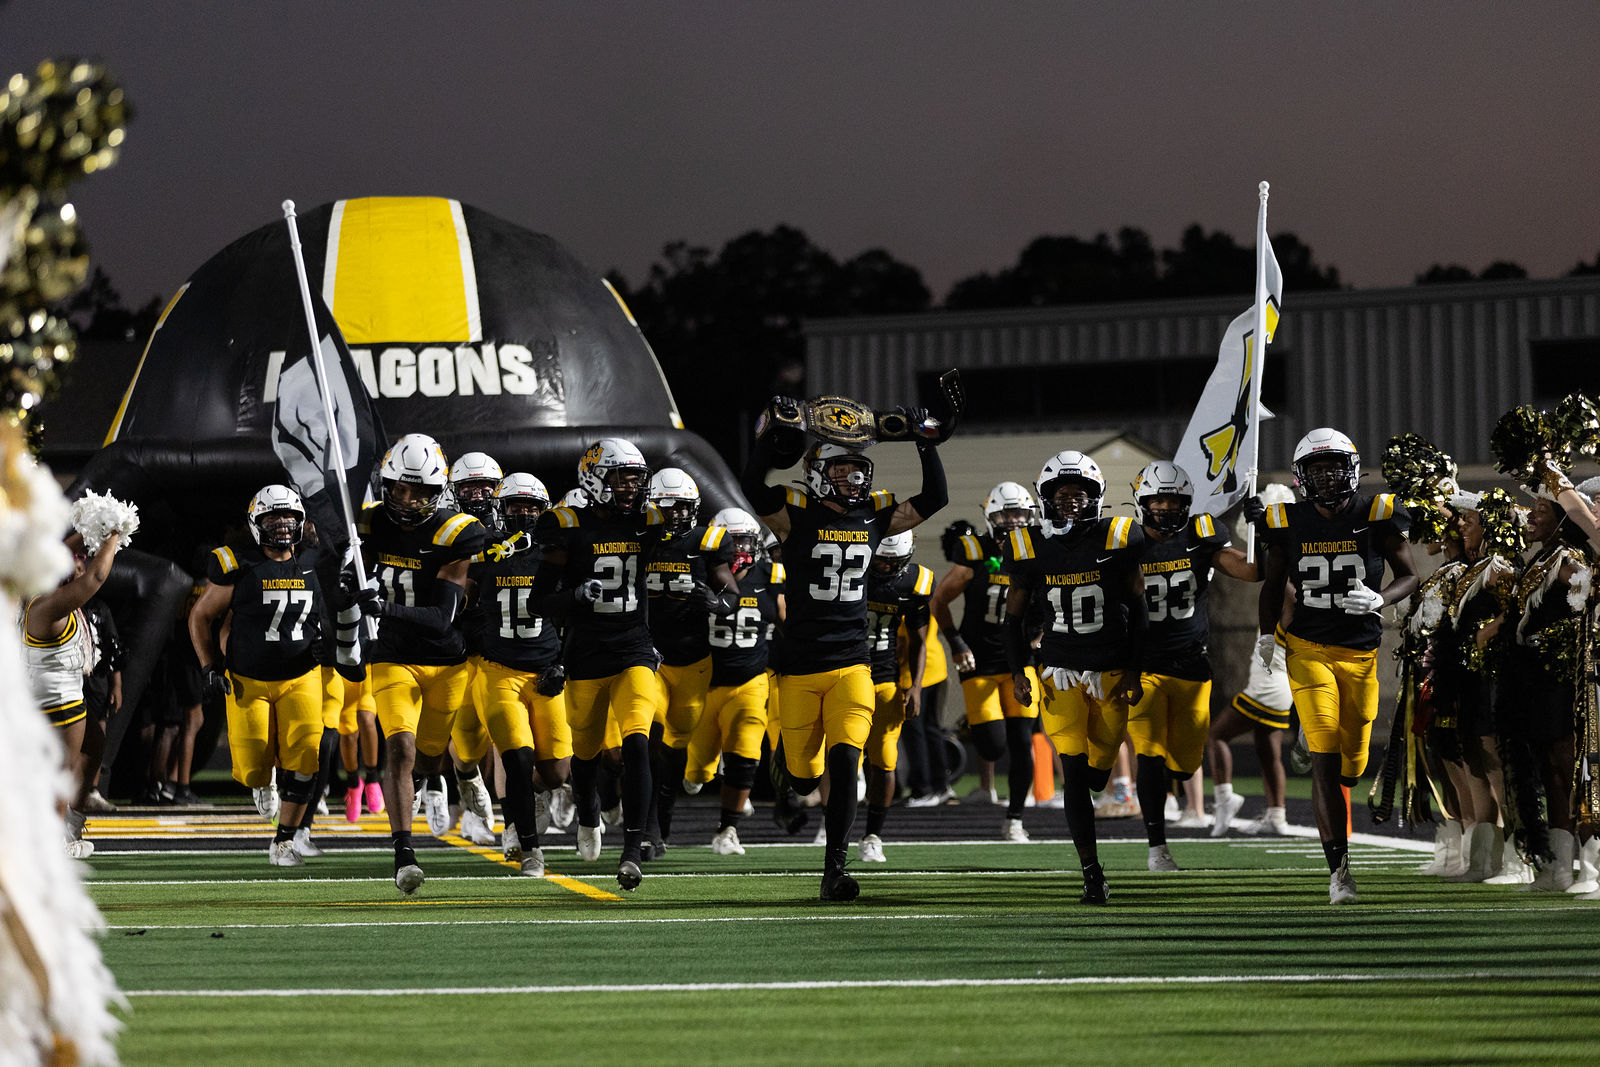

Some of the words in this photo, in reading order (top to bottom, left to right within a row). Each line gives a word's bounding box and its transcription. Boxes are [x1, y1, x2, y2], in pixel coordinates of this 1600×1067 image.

[263, 343, 538, 404] AGONS
[592, 542, 642, 555] NACOGDOCHES
[817, 529, 869, 542] NACOGDOCHES
[1301, 540, 1358, 554] NACOGDOCHES
[262, 578, 306, 590] NACOGDOCHES
[381, 566, 416, 608] 11
[495, 575, 535, 587] NACOGDOC
[593, 554, 639, 613] 21
[645, 562, 691, 573] ACOGDOCHES
[808, 543, 873, 602] 32
[1045, 570, 1101, 585] NACOGDOCHES
[1141, 558, 1192, 574] NACOGDOCHES
[1298, 553, 1367, 609] 23
[262, 590, 314, 642] 77
[496, 588, 543, 640] 15
[1046, 584, 1105, 635] 10
[1143, 570, 1198, 622] 33
[708, 607, 762, 649] 66
